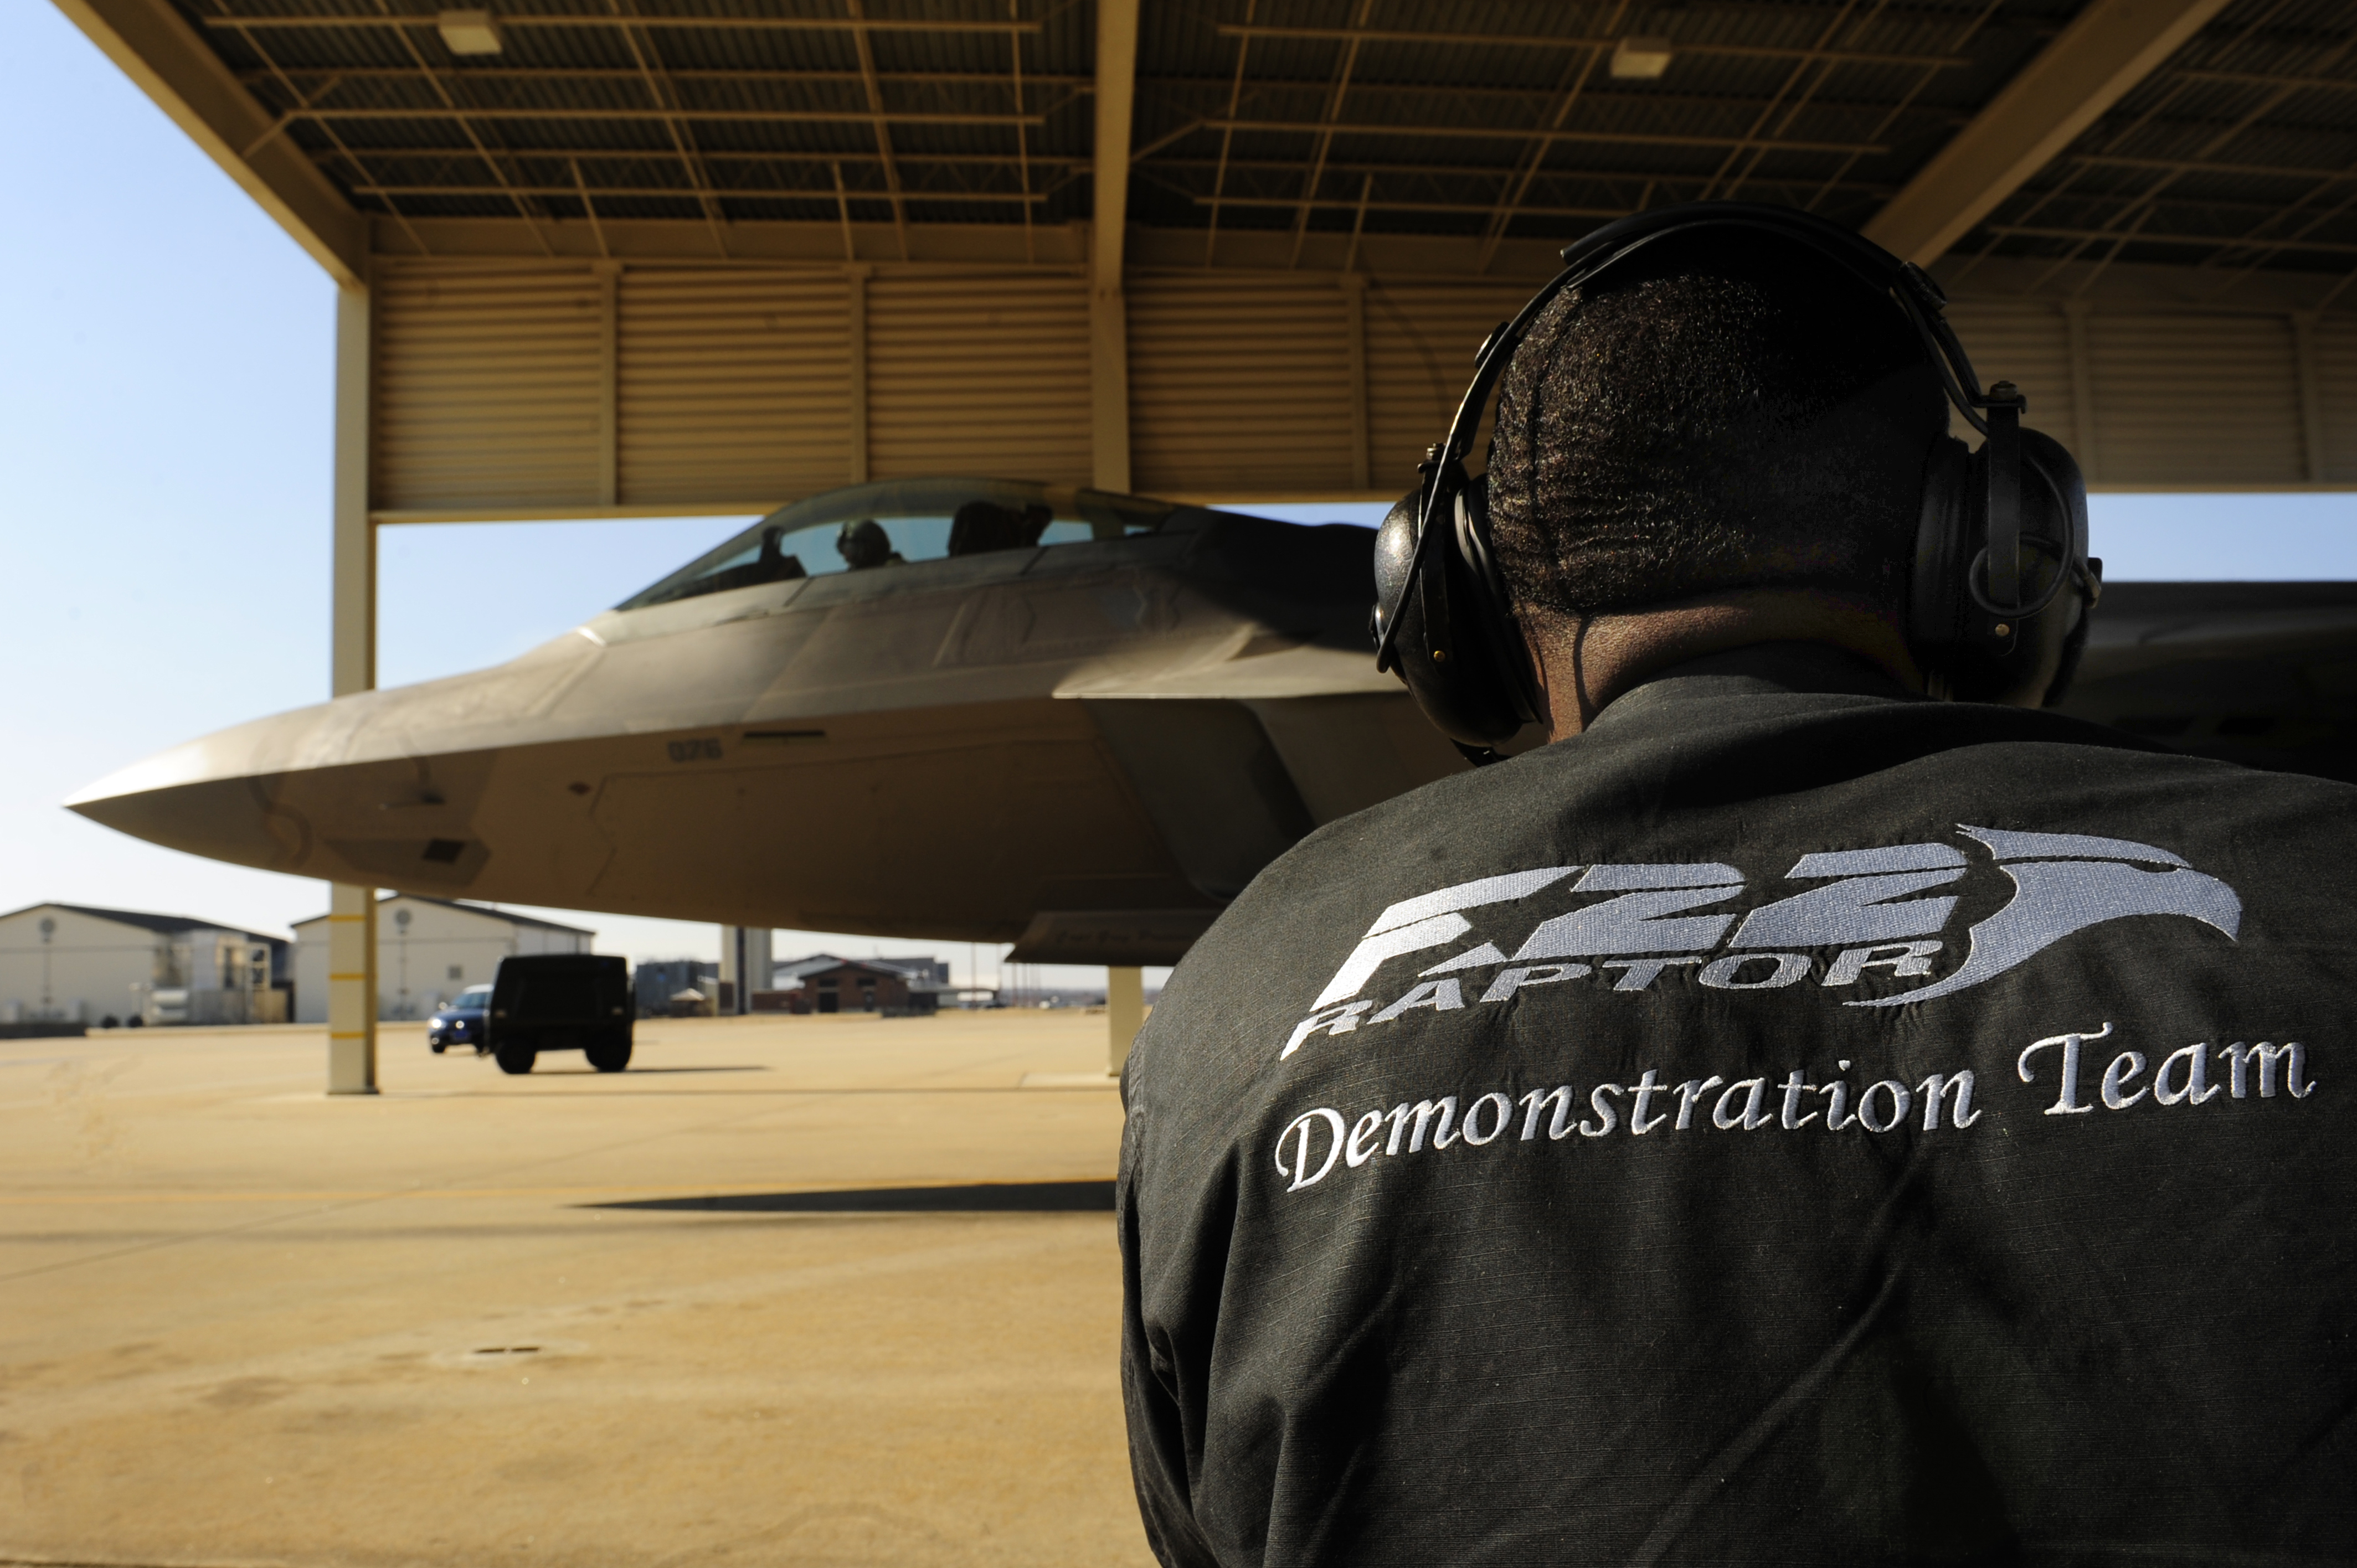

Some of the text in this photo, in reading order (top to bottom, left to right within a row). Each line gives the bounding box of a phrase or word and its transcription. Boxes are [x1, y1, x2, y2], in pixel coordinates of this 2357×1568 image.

[1279, 939, 1943, 1061] RAPTOR
[1274, 1022, 2317, 1193] Demonstration Team
